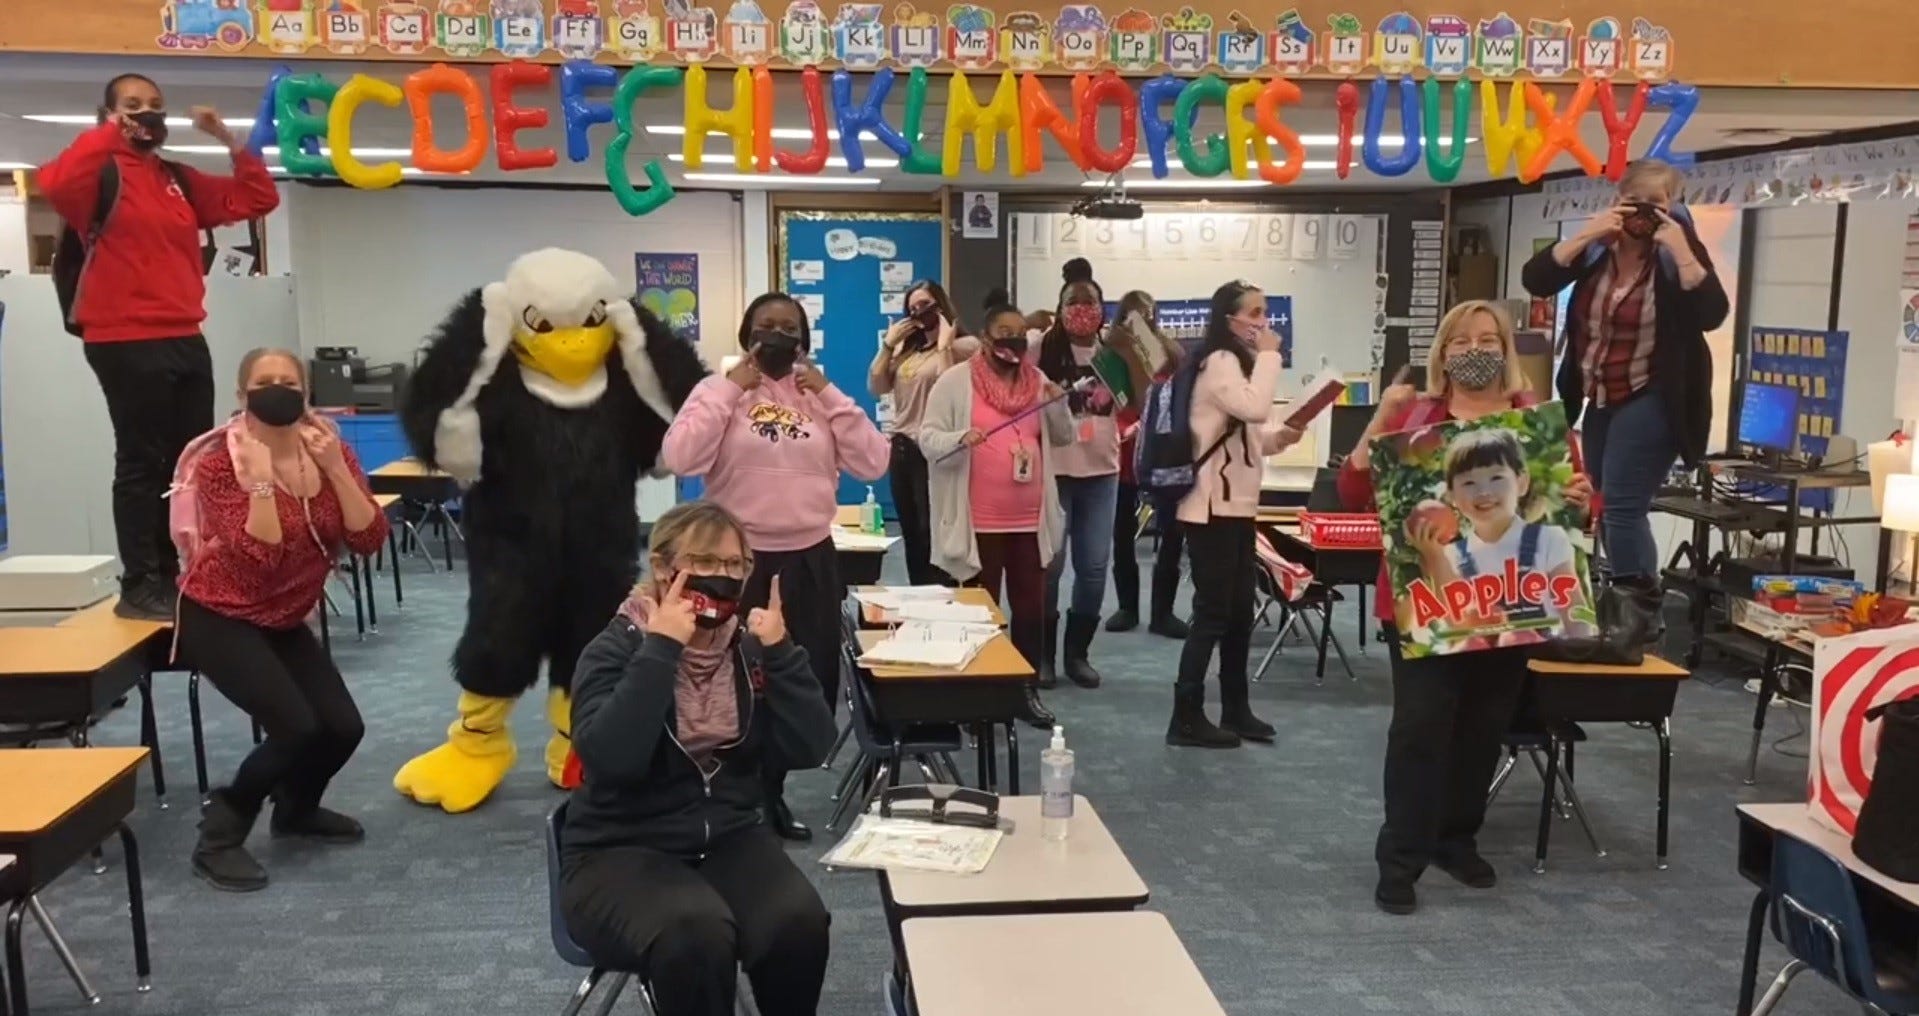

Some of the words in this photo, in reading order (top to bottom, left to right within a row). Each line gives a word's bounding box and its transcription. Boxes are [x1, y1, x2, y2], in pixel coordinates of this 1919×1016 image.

[271, 14, 302, 32] Aa
[331, 15, 359, 33] Bb
[390, 16, 418, 34] Cc
[448, 17, 476, 36] Dd
[507, 18, 531, 37] Ee
[566, 21, 588, 38] Ff
[620, 22, 648, 48] Gg
[792, 26, 814, 50] Jj
[849, 28, 872, 46] Kk
[956, 32, 986, 49] Mm
[1012, 33, 1038, 49] Nn
[1065, 33, 1092, 49] Oo
[1121, 35, 1144, 58] Pp
[1172, 35, 1198, 58] Qq
[1280, 36, 1301, 53] Ss
[1335, 36, 1355, 53] Tt
[1384, 36, 1408, 54] Uu
[1434, 39, 1456, 56] Vv
[1483, 40, 1514, 56] Ww
[1537, 40, 1560, 57] Xx
[1588, 42, 1609, 65] Yy
[1640, 43, 1661, 60] Zz
[327, 73, 404, 189] C
[404, 63, 489, 174] D
[490, 58, 558, 171] E
[561, 59, 618, 162] F
[683, 62, 753, 172] H
[752, 65, 774, 172] I
[773, 64, 830, 174] J
[831, 67, 913, 172] K
[902, 66, 944, 174] L
[941, 69, 1026, 177] M
[1019, 71, 1091, 172] N
[1079, 70, 1137, 173] O
[1255, 76, 1306, 185] S
[1362, 74, 1422, 177] U
[1480, 79, 1557, 185] W
[1524, 78, 1601, 183] X
[1597, 79, 1650, 182] Y
[1642, 80, 1699, 170] Z
[1060, 218, 1077, 243] 2
[1095, 219, 1114, 244] 3
[1128, 219, 1147, 249] 4
[1165, 219, 1183, 244] 5
[1200, 217, 1216, 242] 6
[1234, 218, 1253, 248] 7
[1267, 217, 1283, 245] 8
[1305, 219, 1320, 251] 9
[1336, 219, 1357, 246] 10
[1407, 557, 1578, 628] Apples
